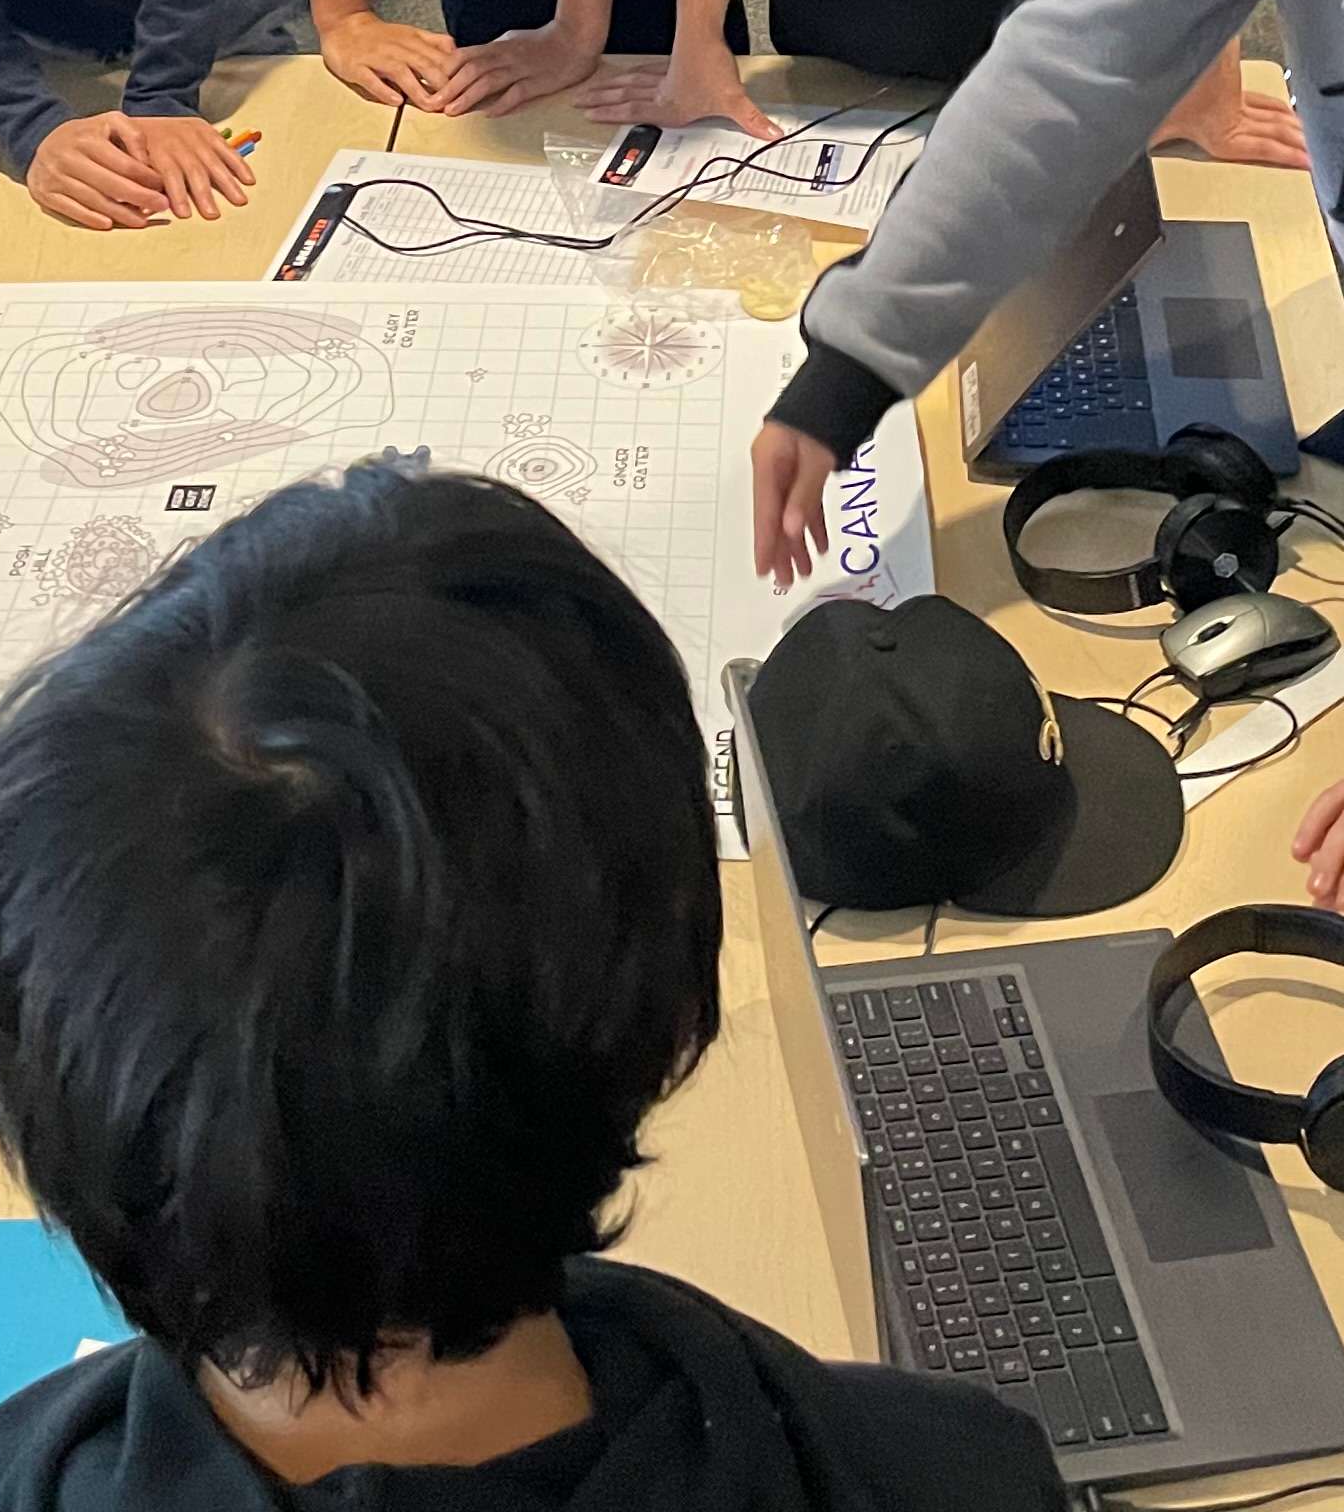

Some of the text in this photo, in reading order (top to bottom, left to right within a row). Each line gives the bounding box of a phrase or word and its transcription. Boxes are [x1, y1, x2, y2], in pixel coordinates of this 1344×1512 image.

[400, 308, 421, 348] CRATER
[633, 445, 649, 490] CRATER
[9, 544, 33, 576] POSH
